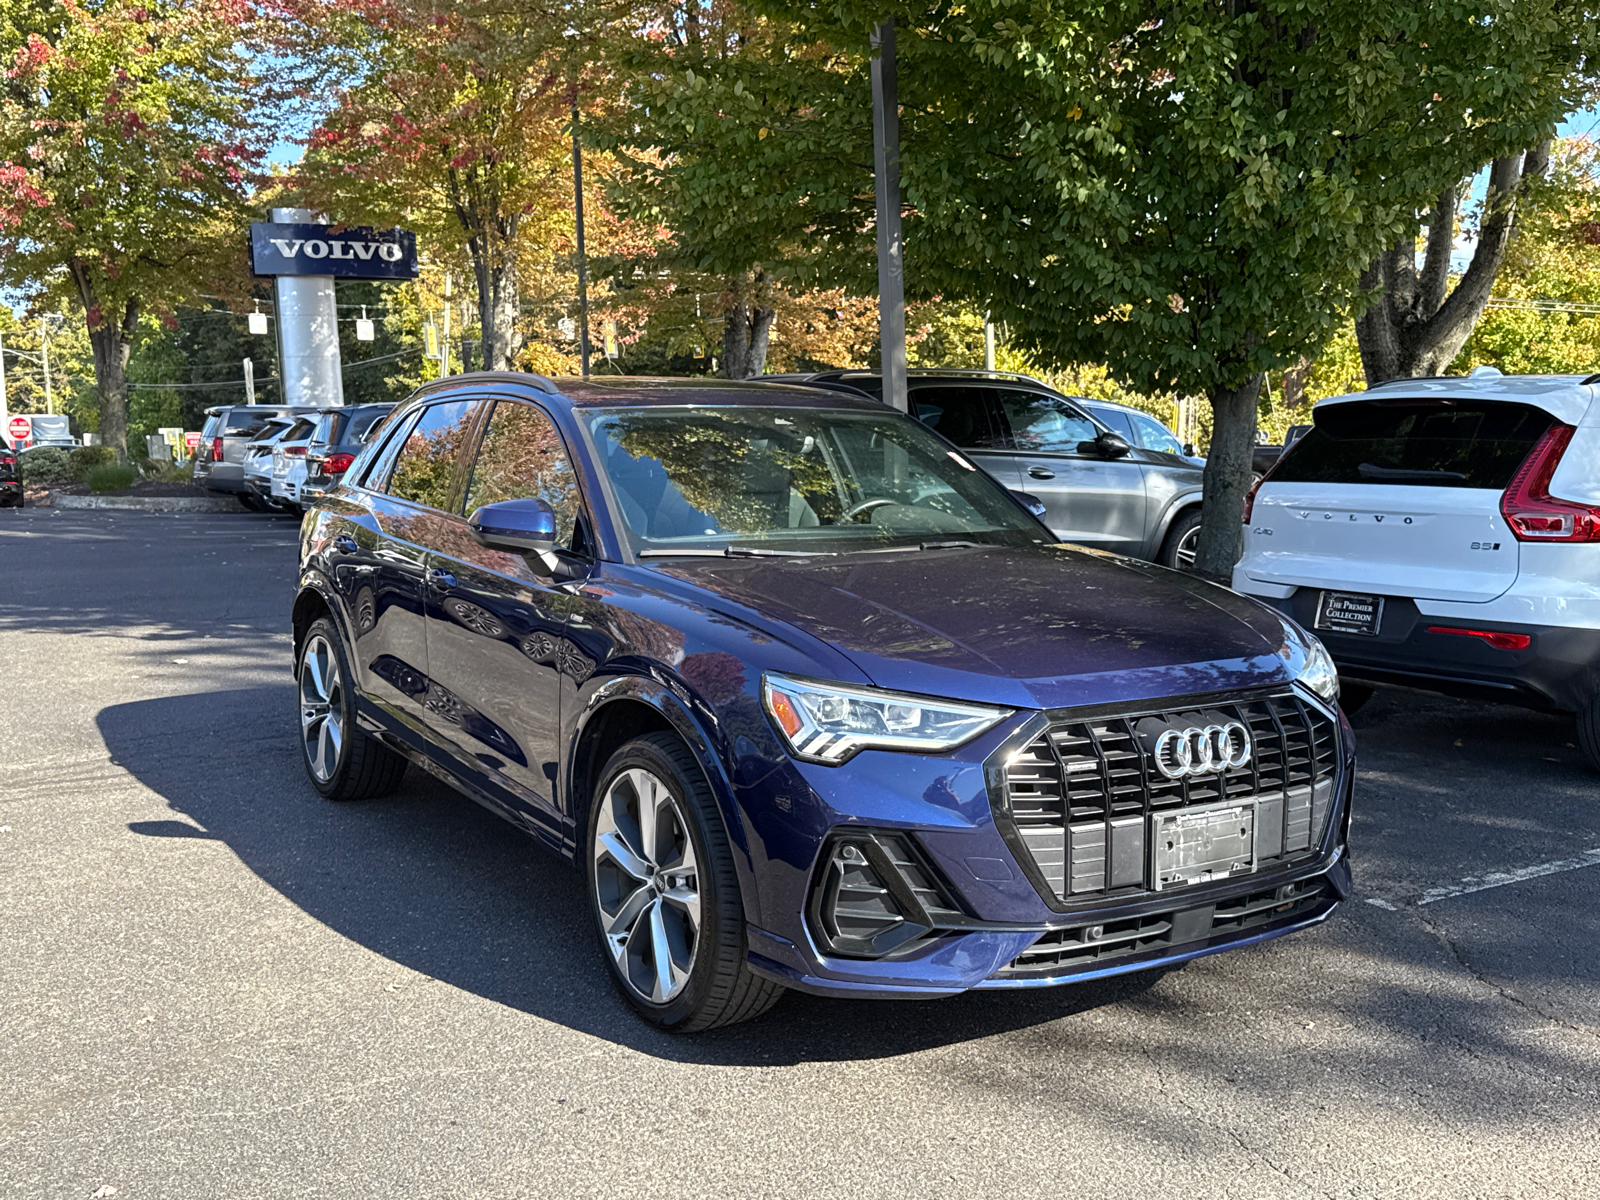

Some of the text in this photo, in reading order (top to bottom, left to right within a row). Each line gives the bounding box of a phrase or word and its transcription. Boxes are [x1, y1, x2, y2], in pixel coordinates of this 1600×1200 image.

[270, 238, 403, 262] VOLVO
[1300, 511, 1414, 525] VOLVO
[1343, 600, 1373, 612] PREMIER
[1326, 608, 1372, 622] COLLECTION
